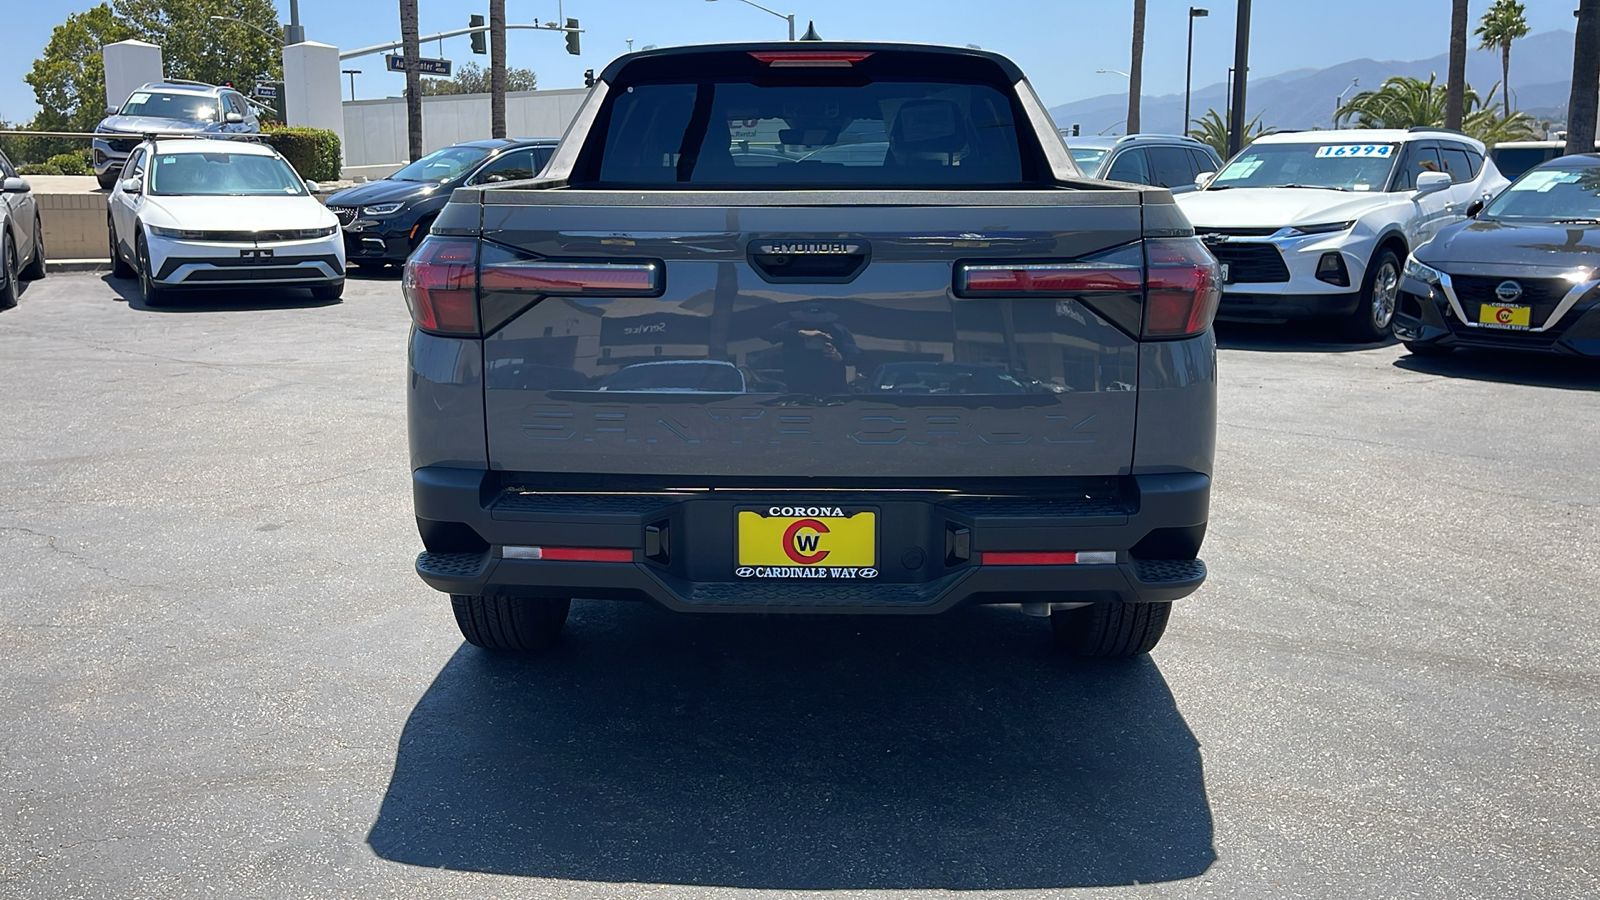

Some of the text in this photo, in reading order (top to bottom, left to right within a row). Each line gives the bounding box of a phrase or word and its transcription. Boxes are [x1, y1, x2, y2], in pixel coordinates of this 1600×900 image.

[771, 242, 848, 254] HYUNDAI
[521, 404, 1099, 444] SANTA CRUZ
[768, 506, 845, 517] CORONA
[755, 567, 858, 578] CARDINALE WAY
